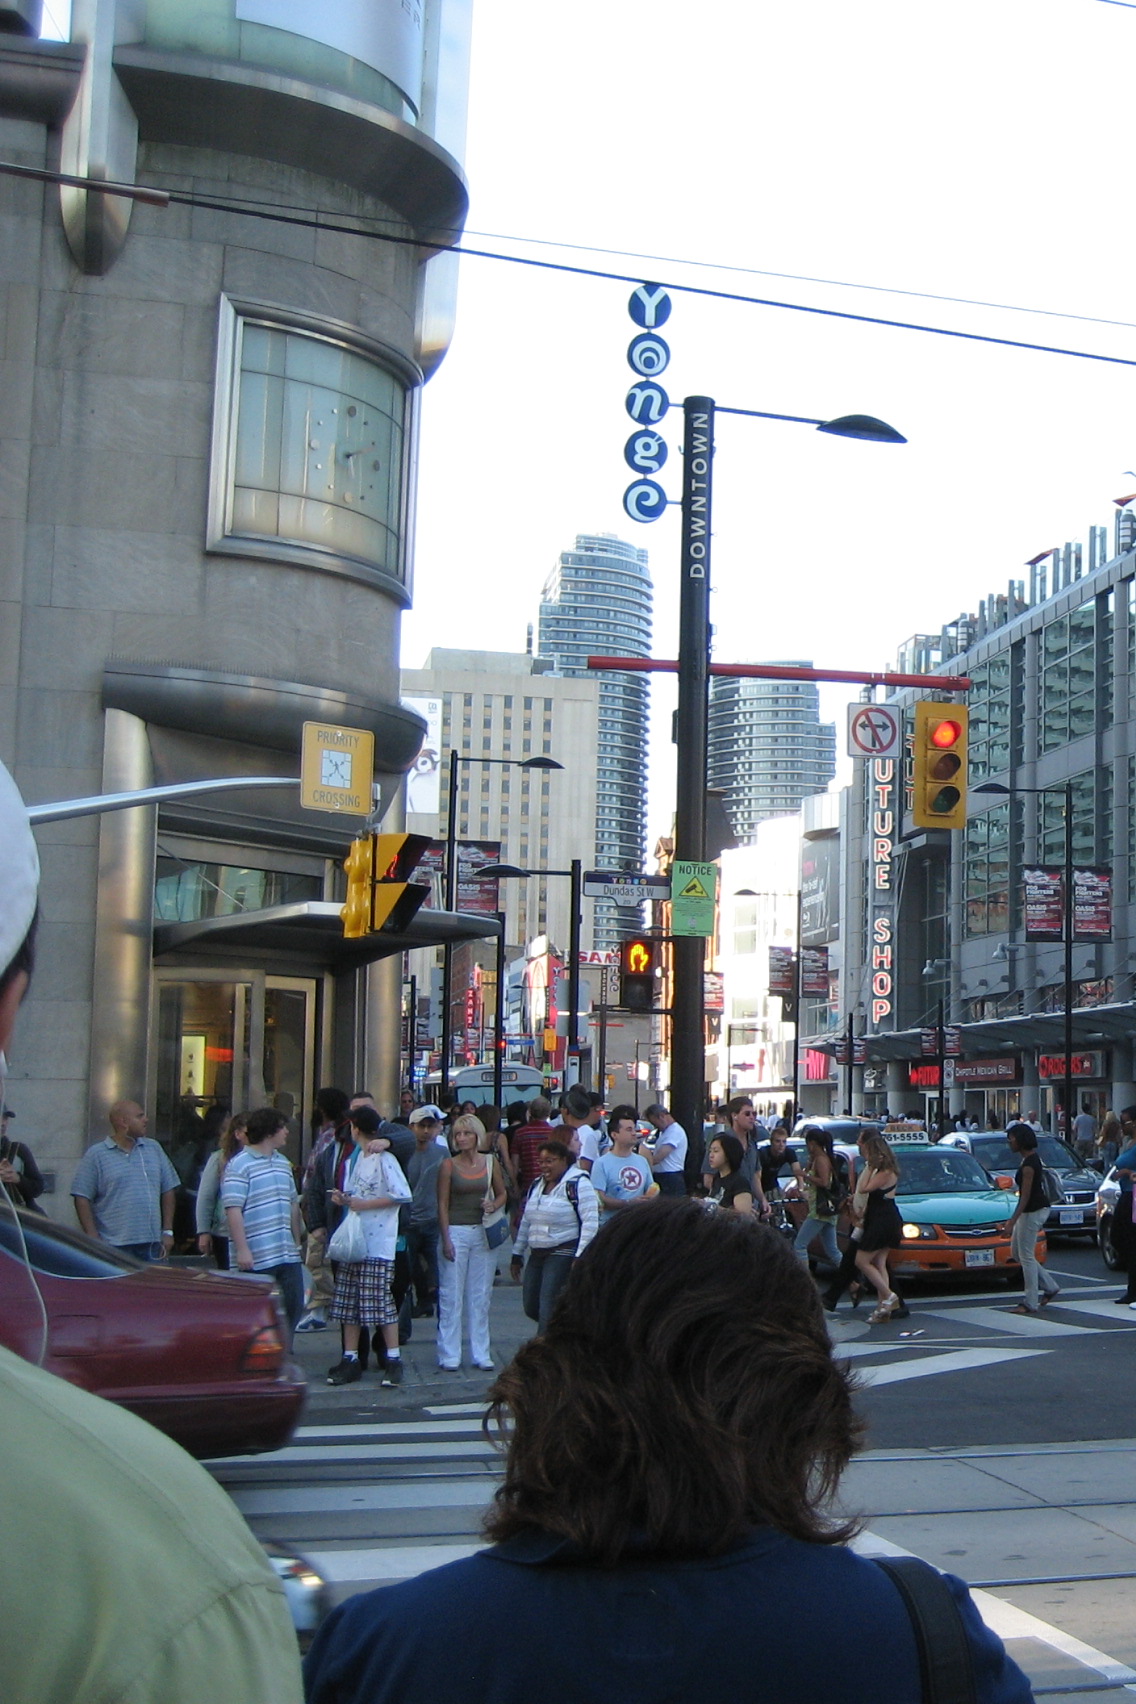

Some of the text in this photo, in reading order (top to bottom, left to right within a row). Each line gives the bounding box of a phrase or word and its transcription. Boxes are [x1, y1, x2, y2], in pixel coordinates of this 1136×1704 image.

[690, 412, 709, 578] DOWNTOWN
[317, 730, 359, 748] PRIORITY
[313, 789, 360, 808] CROSSING
[872, 758, 894, 890] UTURE
[679, 865, 712, 876] NOTICE
[603, 884, 655, 897] Dundas St W
[872, 917, 893, 1024] SHOP
[1048, 1057, 1082, 1075] ROGRS
